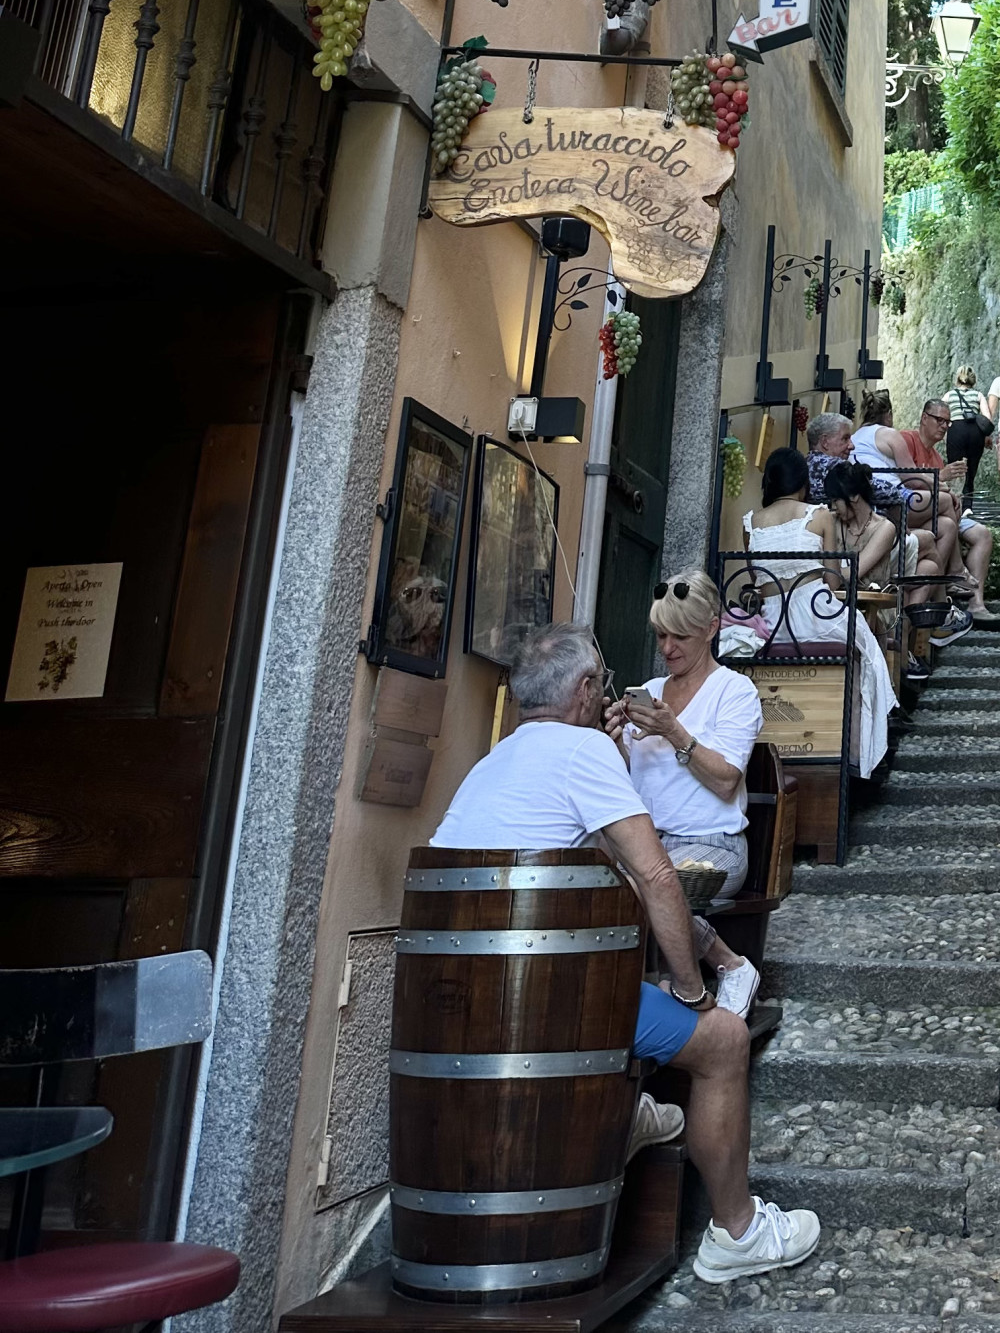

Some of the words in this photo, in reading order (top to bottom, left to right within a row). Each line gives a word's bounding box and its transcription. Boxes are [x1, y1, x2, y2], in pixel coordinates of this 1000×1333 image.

[734, 9, 801, 44] Bar
[463, 167, 577, 213] Enoteca
[592, 159, 662, 222] Wine
[656, 205, 702, 249] bar
[38, 617, 59, 628] Push
[75, 616, 96, 626] door
